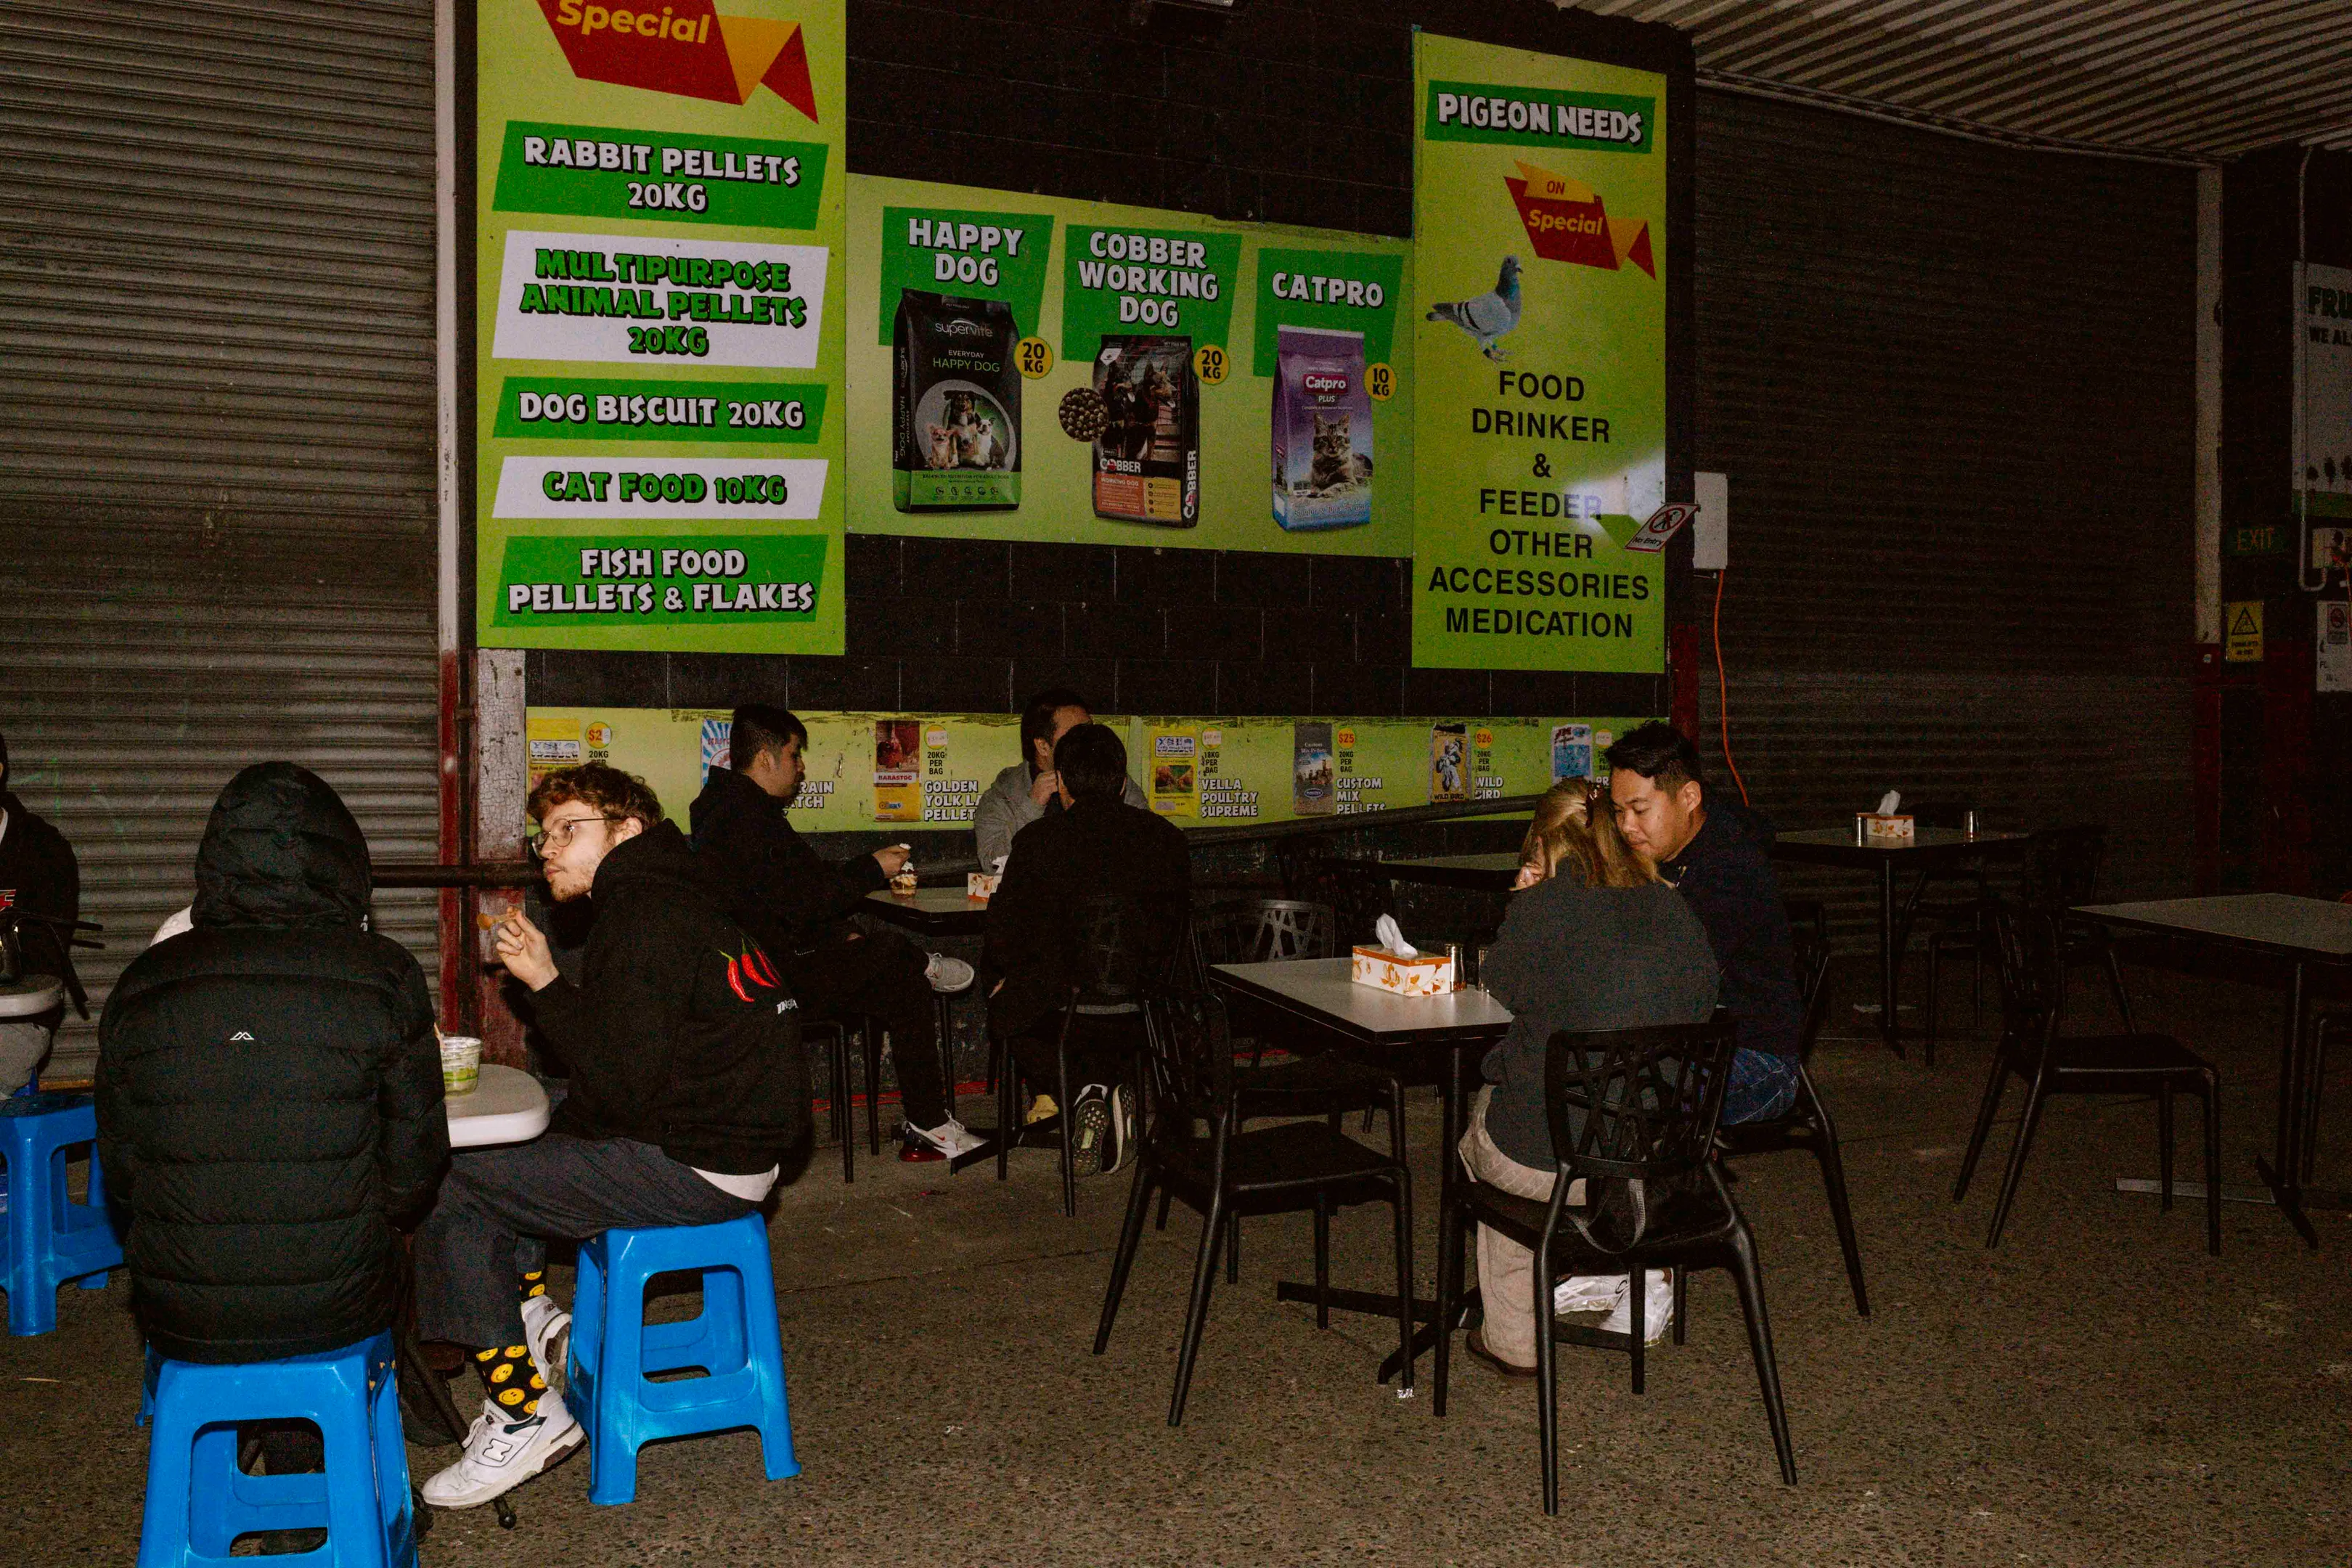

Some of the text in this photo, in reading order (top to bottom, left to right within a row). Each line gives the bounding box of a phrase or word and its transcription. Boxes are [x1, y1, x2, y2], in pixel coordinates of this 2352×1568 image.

[556, 0, 711, 44] Special
[1437, 92, 1643, 144] PIGEON NEEDS
[523, 136, 801, 187] RABBIT PELLETS
[1547, 181, 1565, 195] ON
[627, 182, 709, 213] 20KG
[1528, 209, 1604, 236] Special
[908, 217, 1024, 257] HAPPY
[1089, 231, 1208, 270] COBBER
[535, 248, 791, 293] MULTIPURPOSE
[934, 253, 999, 287] DOG
[1078, 261, 1219, 302] WORKING
[1272, 272, 1384, 307] CATPRO
[520, 284, 806, 328] ANIMAL PELLETS
[1119, 295, 1179, 327] DOG
[935, 321, 994, 338] supervite
[2310, 327, 2352, 346] WE AL
[628, 327, 709, 356] 20KG
[948, 349, 984, 359] EVERYDAY
[1022, 343, 1045, 361] 20
[1201, 350, 1222, 367] 20
[933, 357, 1000, 373] HAPPY DOG
[1024, 359, 1045, 374] KG
[1202, 366, 1222, 380] KG
[1305, 375, 1347, 392] Catpro
[1373, 368, 1389, 383] 10
[1372, 384, 1390, 396] KG
[1499, 370, 1585, 401] FOOD
[518, 391, 805, 429] DOG BISCUIT 20KG
[1472, 407, 1609, 443] DRINKER
[1099, 457, 1141, 473] COBBER
[1532, 453, 1552, 478] &
[542, 471, 787, 505] CAT FOOD 10KG
[1183, 450, 1198, 519] COBBER
[1479, 489, 1602, 520] FEEDER
[1490, 529, 1593, 558] OTHER
[1643, 538, 1662, 547] Entry
[2237, 527, 2275, 552] EXIT
[581, 548, 748, 579] FISH FOOD
[1429, 567, 1649, 600] ACCESSORIES
[508, 582, 816, 613] PELLETS & FLAKES
[1446, 608, 1633, 637] MEDICATION
[589, 729, 603, 742] $2
[1338, 734, 1355, 743] $25
[1477, 734, 1492, 743] $26
[799, 781, 834, 793] RAIN
[924, 780, 979, 793] GOLDEN
[1201, 778, 1242, 791] VELLA
[1336, 777, 1382, 789] CUSTOM
[1476, 777, 1503, 788] WILD
[791, 796, 825, 809] TCH
[924, 794, 963, 807] YOLK
[1201, 792, 1258, 804] POULTRY
[1336, 791, 1360, 802] MIX
[1474, 788, 1502, 799] BIRD
[924, 809, 976, 822] PELLET
[1201, 805, 1258, 817] SUPREME
